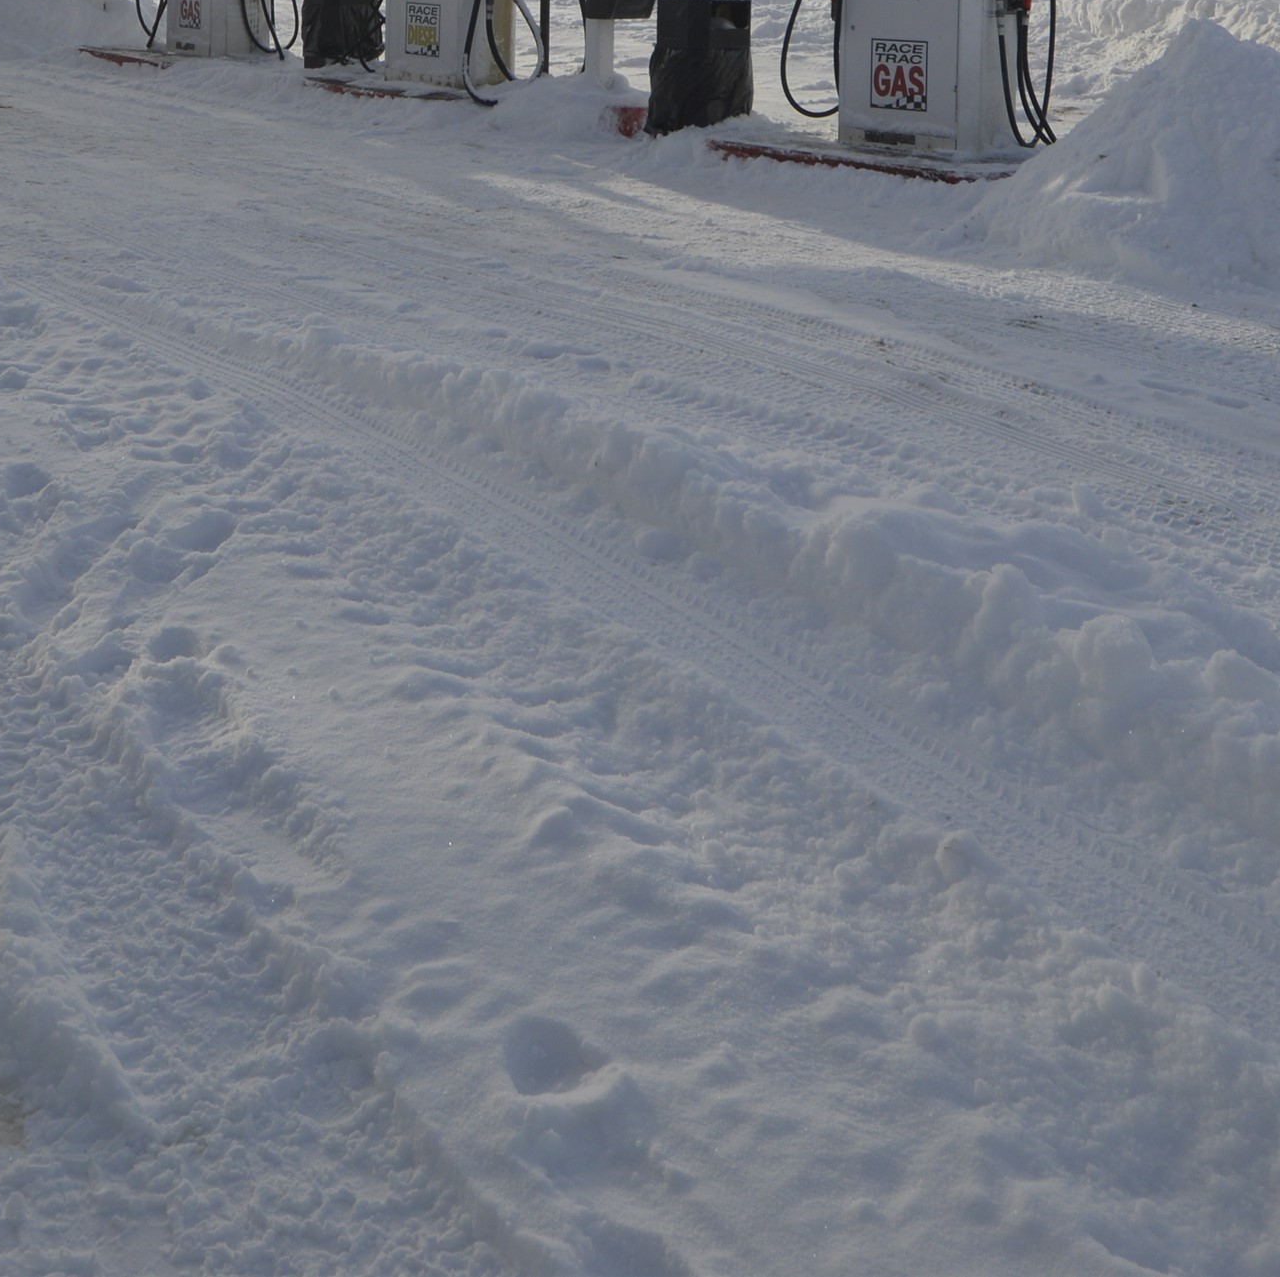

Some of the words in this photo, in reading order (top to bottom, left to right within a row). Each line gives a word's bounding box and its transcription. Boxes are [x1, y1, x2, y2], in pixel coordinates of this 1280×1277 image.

[181, 0, 200, 20] GAS
[408, 5, 438, 16] RACE
[408, 14, 438, 25] TRAC
[408, 24, 437, 46] DIESEL
[875, 42, 924, 54] RACE
[875, 53, 923, 64] TRAC
[873, 63, 925, 98] GAS
